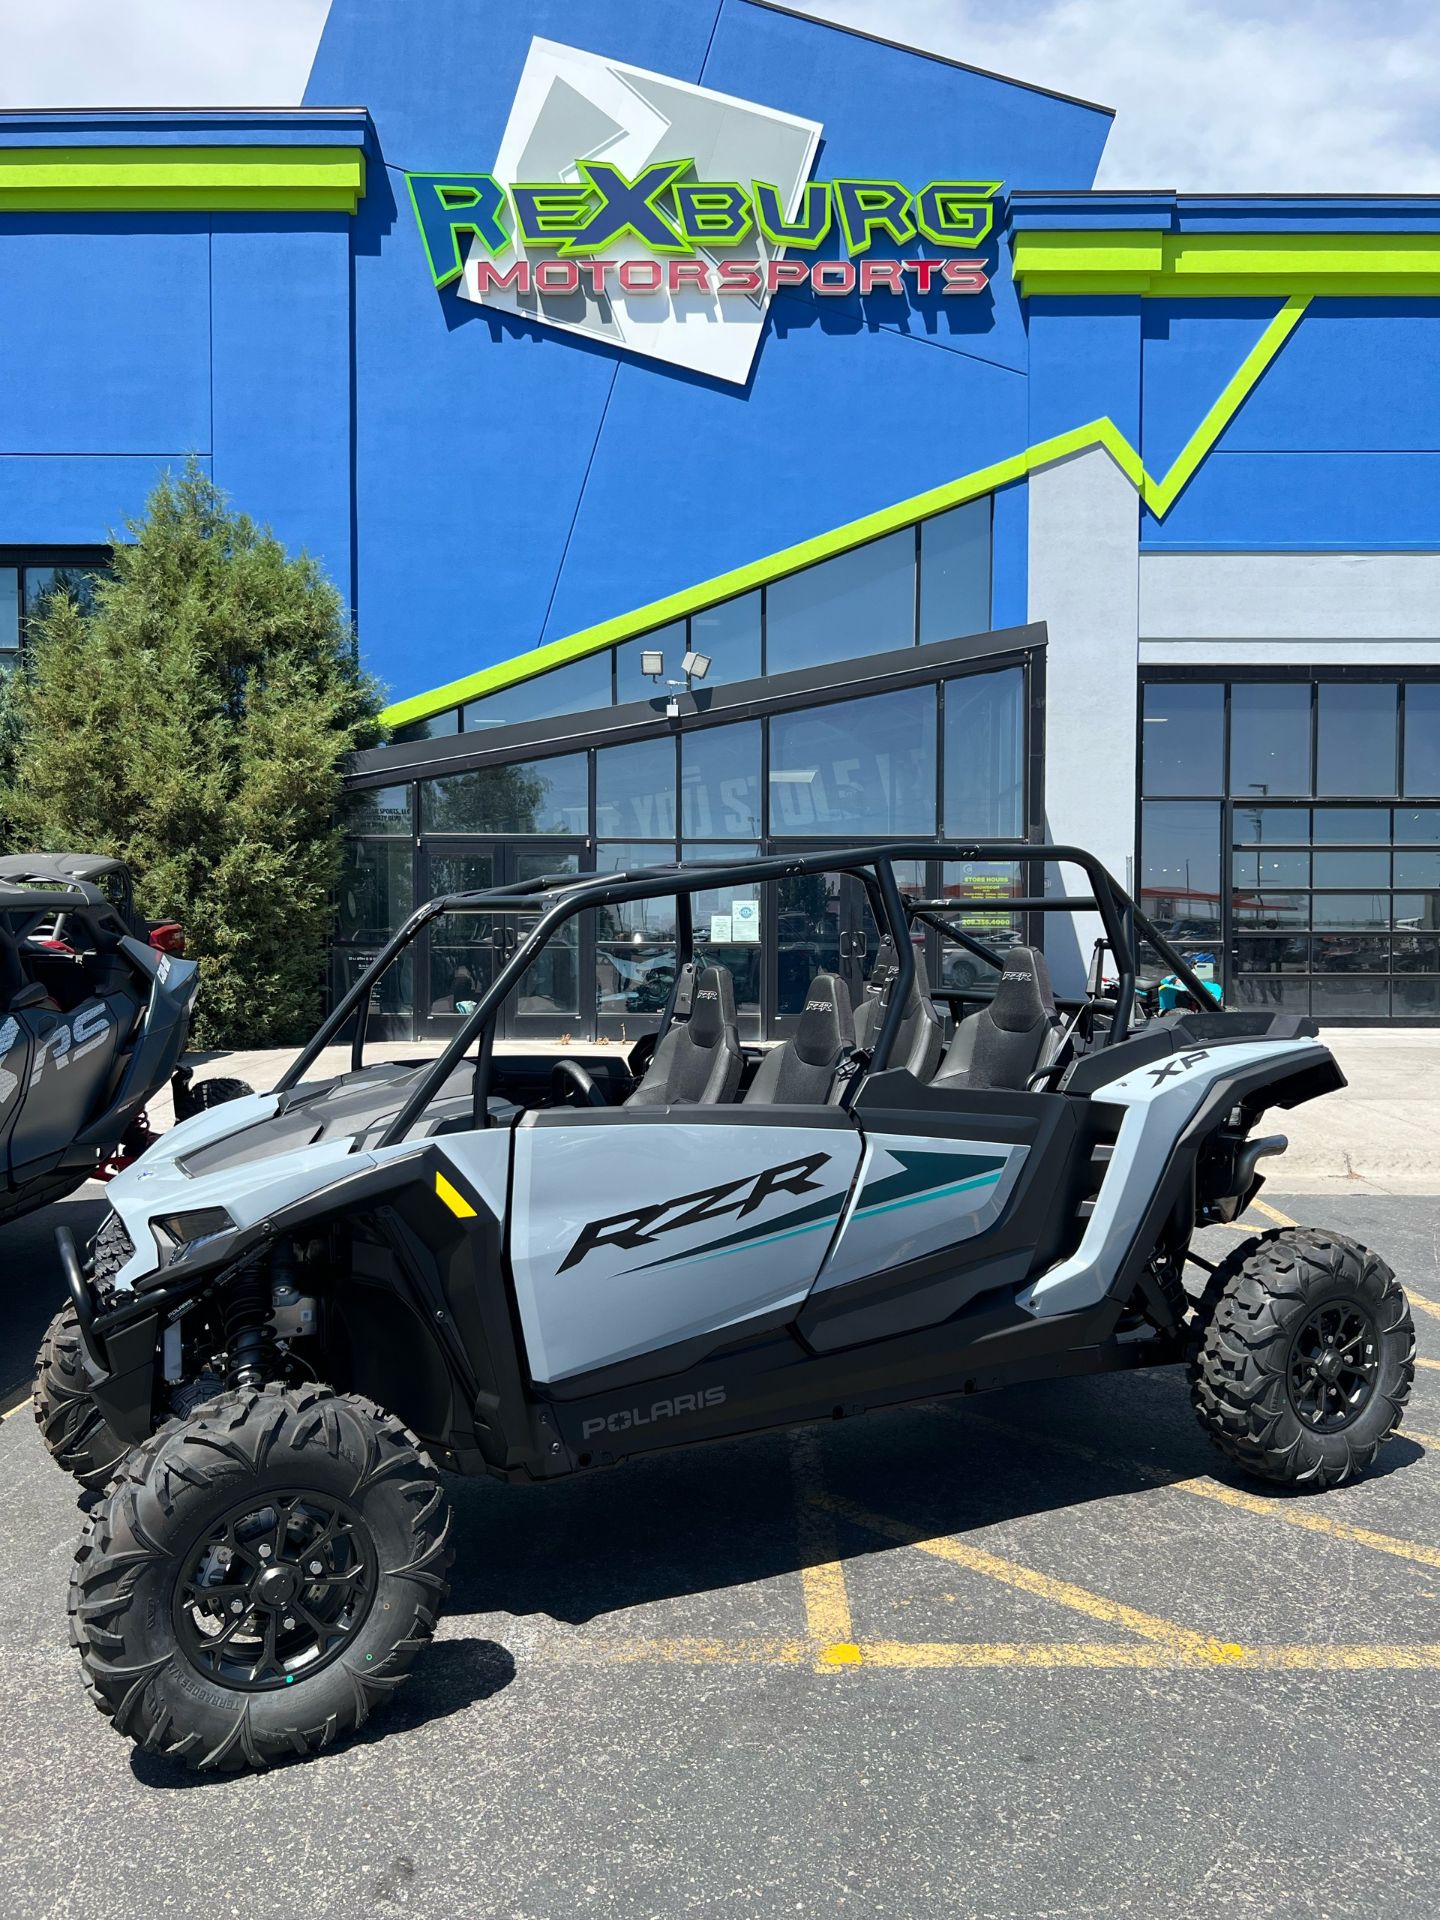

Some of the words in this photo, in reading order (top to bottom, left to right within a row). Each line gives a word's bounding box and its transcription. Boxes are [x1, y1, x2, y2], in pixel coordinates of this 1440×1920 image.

[405, 157, 1006, 289] REXBURG
[477, 258, 991, 295] MOTORSPORTS
[1001, 971, 1032, 981] RZR
[805, 1000, 833, 1012] RZR
[1145, 1050, 1211, 1089] XP
[554, 1151, 833, 1277] RZR
[582, 1384, 727, 1440] POLARIS
